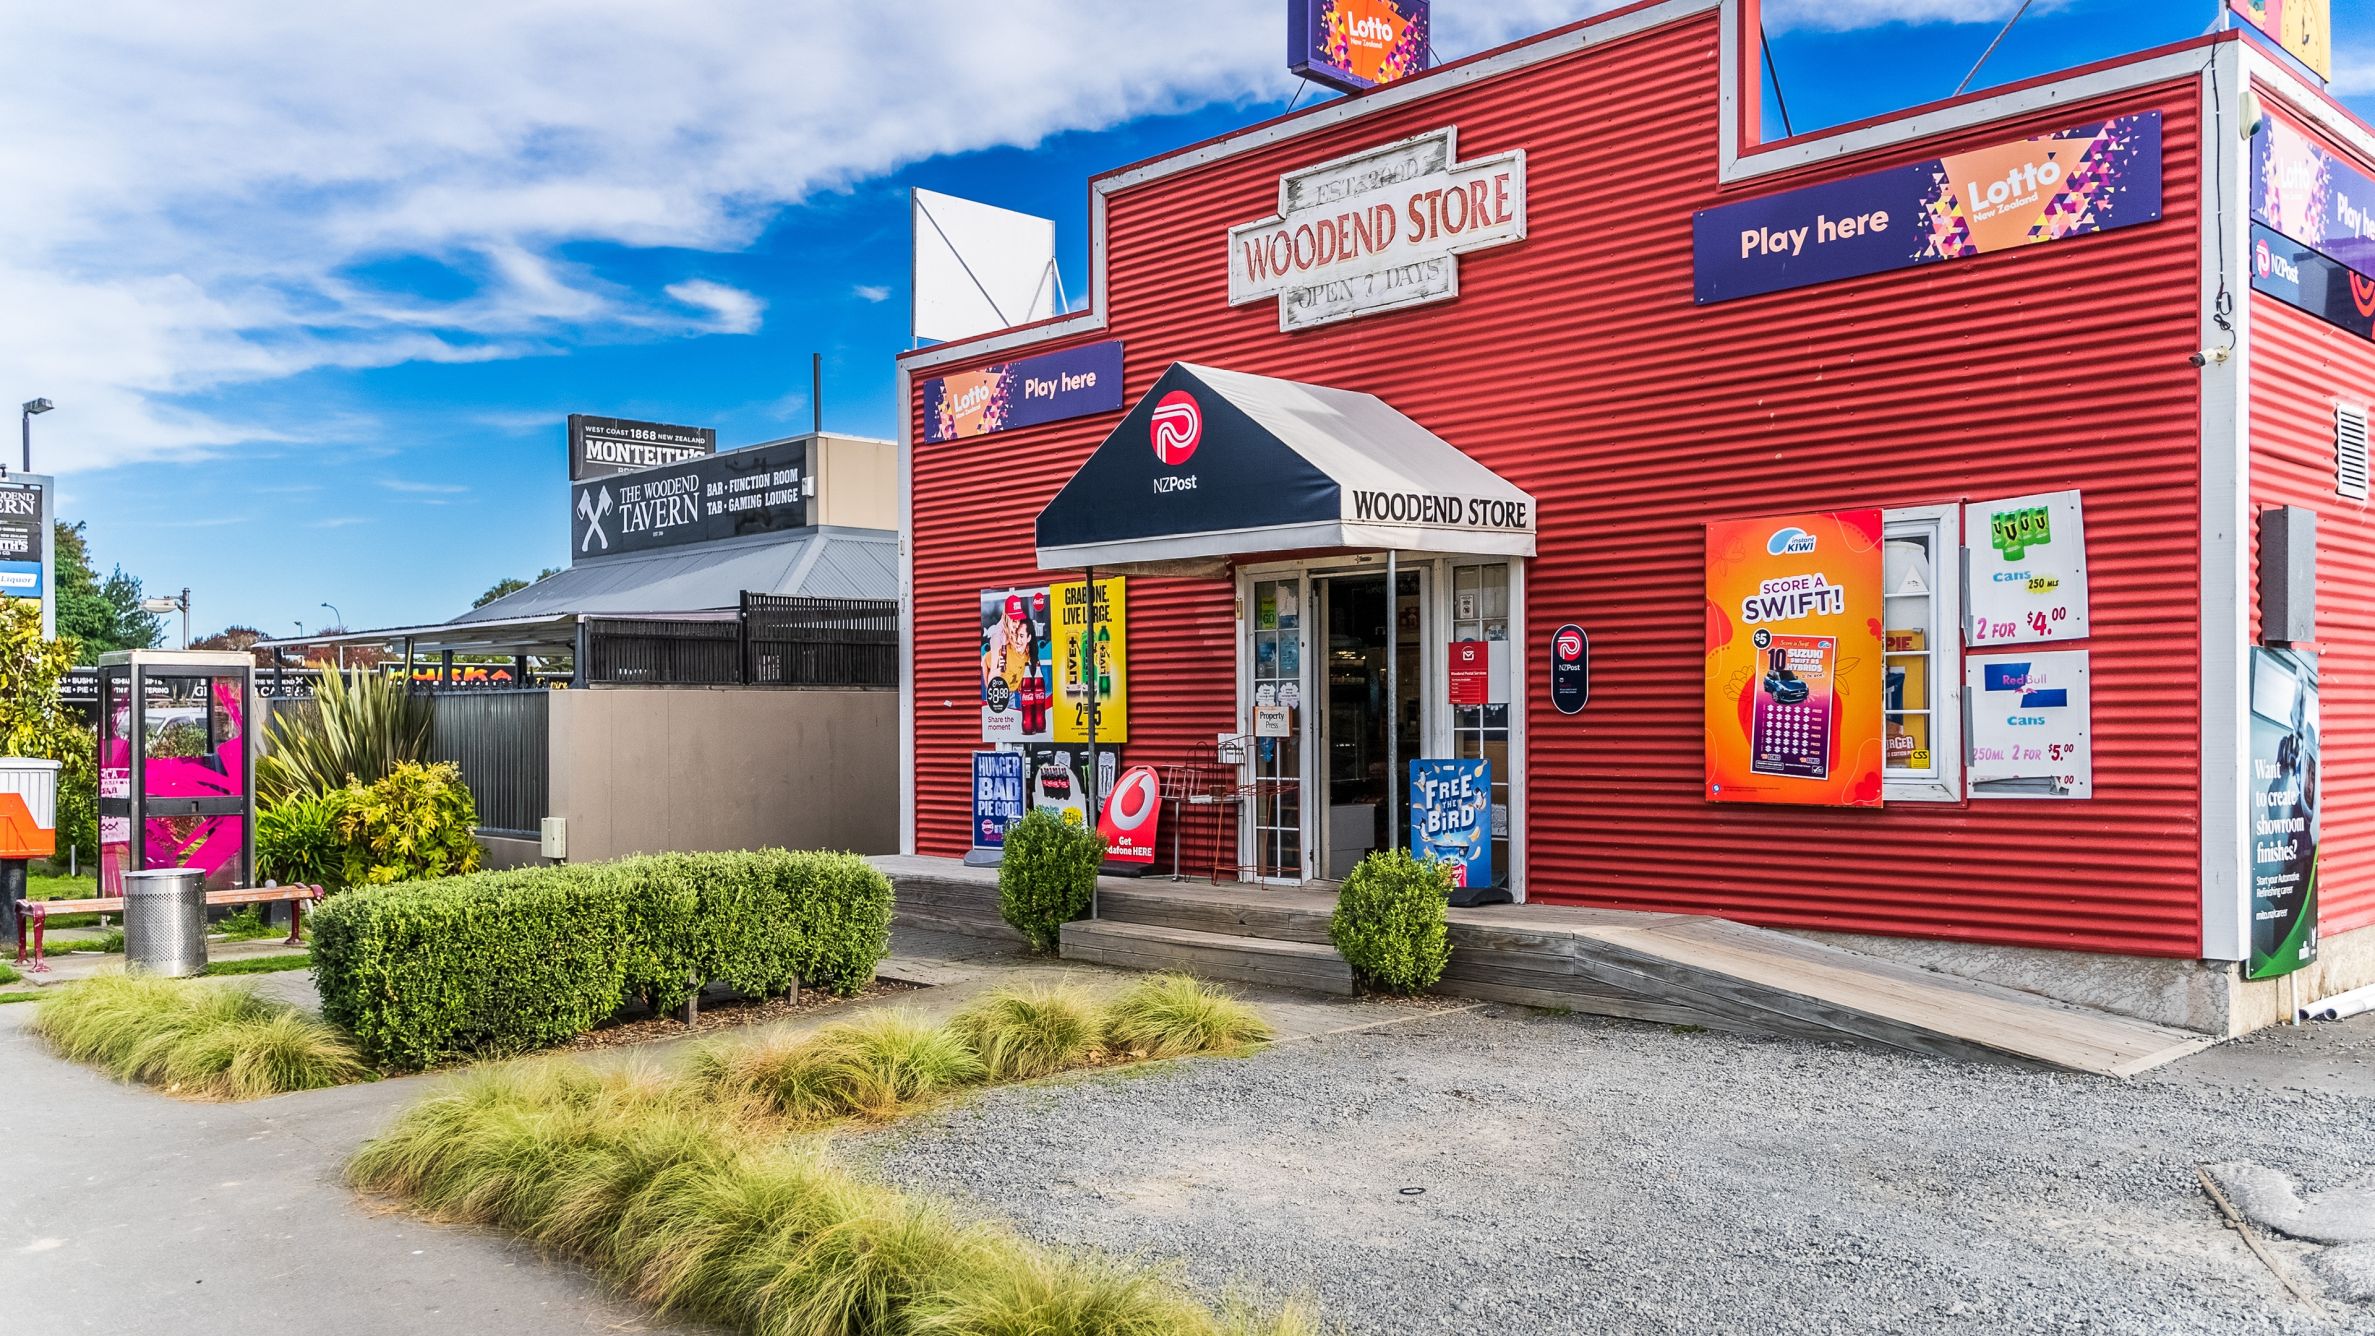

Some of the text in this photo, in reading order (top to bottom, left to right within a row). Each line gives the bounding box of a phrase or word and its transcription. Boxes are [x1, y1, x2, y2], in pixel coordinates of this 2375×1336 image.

[1348, 11, 1393, 41] Lotto
[1968, 159, 2061, 211] Lotto
[1973, 192, 2038, 223] New Zealand
[2337, 192, 2361, 239] Play
[1244, 173, 1513, 283] WOODEND STORE
[1741, 210, 1889, 258] Play here
[2271, 253, 2299, 284] NZPost
[1298, 260, 1440, 309] OPEN 7 DAYS
[1025, 371, 1096, 399] Play here
[954, 384, 989, 412] Lotto
[606, 427, 628, 436] COAST
[630, 428, 656, 440] 1868
[675, 436, 705, 444] ZEALAND
[620, 475, 699, 504] THE WOODEND
[707, 468, 798, 497] BAR FUNCTION ROOM
[1153, 474, 1197, 494] NZPost
[707, 488, 798, 516] TAB GAMING LOUNGE
[1353, 490, 1526, 528] WOODEND STORE
[619, 492, 700, 533] TAVERN
[1787, 543, 1814, 552] KIWI
[1763, 577, 1824, 594] SCORE A
[2029, 579, 2044, 589] 250
[1063, 605, 1112, 625] LIVE LRGE.
[1745, 589, 1841, 621] SWIFT!
[1976, 607, 2066, 639] 2 FOR $4.00
[1755, 633, 1767, 645] $5
[1886, 636, 1912, 651] PIE
[1768, 648, 1786, 671] 10
[1787, 649, 1823, 658] SUZUKI
[1786, 664, 1823, 672] HYBRIDS
[145, 686, 169, 694] TERING
[1076, 702, 1083, 726] 2
[1260, 711, 1284, 720] Property
[1886, 736, 1914, 749] RGER
[1973, 744, 2074, 761] 250ML 2 FOR $5.00
[1913, 751, 1927, 759] CSS
[978, 756, 1020, 776] HUNGER
[2255, 759, 2281, 779] Want
[1426, 774, 1472, 809] FREE
[2256, 790, 2296, 807] to create
[978, 801, 1020, 816] PIE GOOD
[1442, 800, 1456, 809] THE
[2256, 814, 2304, 836] showroom
[1106, 845, 1152, 856] dafone HERE
[1119, 836, 1132, 846] Get
[2257, 839, 2298, 863] finishes?
[2256, 875, 2267, 885] Start
[2268, 876, 2278, 887] your
[2256, 886, 2293, 898] Refinishing career
